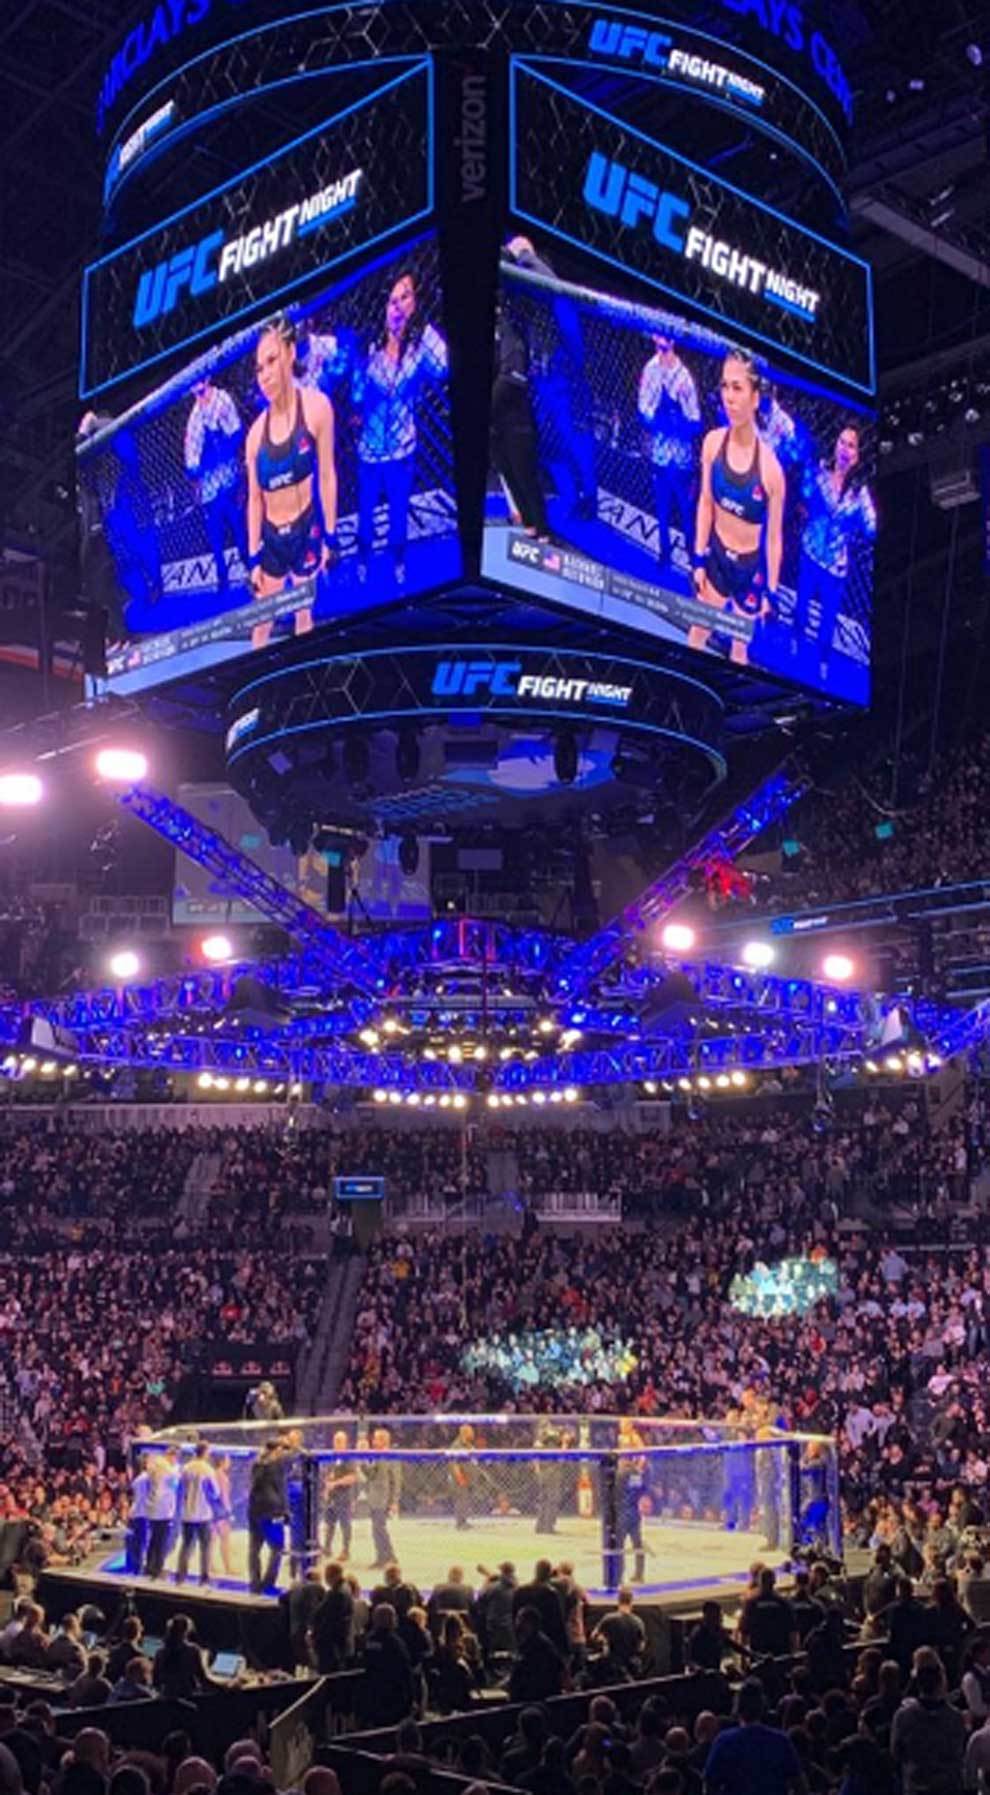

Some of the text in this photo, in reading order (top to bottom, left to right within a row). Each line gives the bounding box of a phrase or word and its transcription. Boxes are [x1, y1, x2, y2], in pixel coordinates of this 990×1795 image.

[588, 19, 672, 67] UFC
[667, 49, 730, 88] FIGHT
[453, 76, 486, 202] verizon
[133, 168, 363, 330] UFC FIGHT NIGHT
[583, 151, 820, 313] UFC FIGHT NIGHT
[432, 662, 632, 701] UFC FIGHT NIGHT
